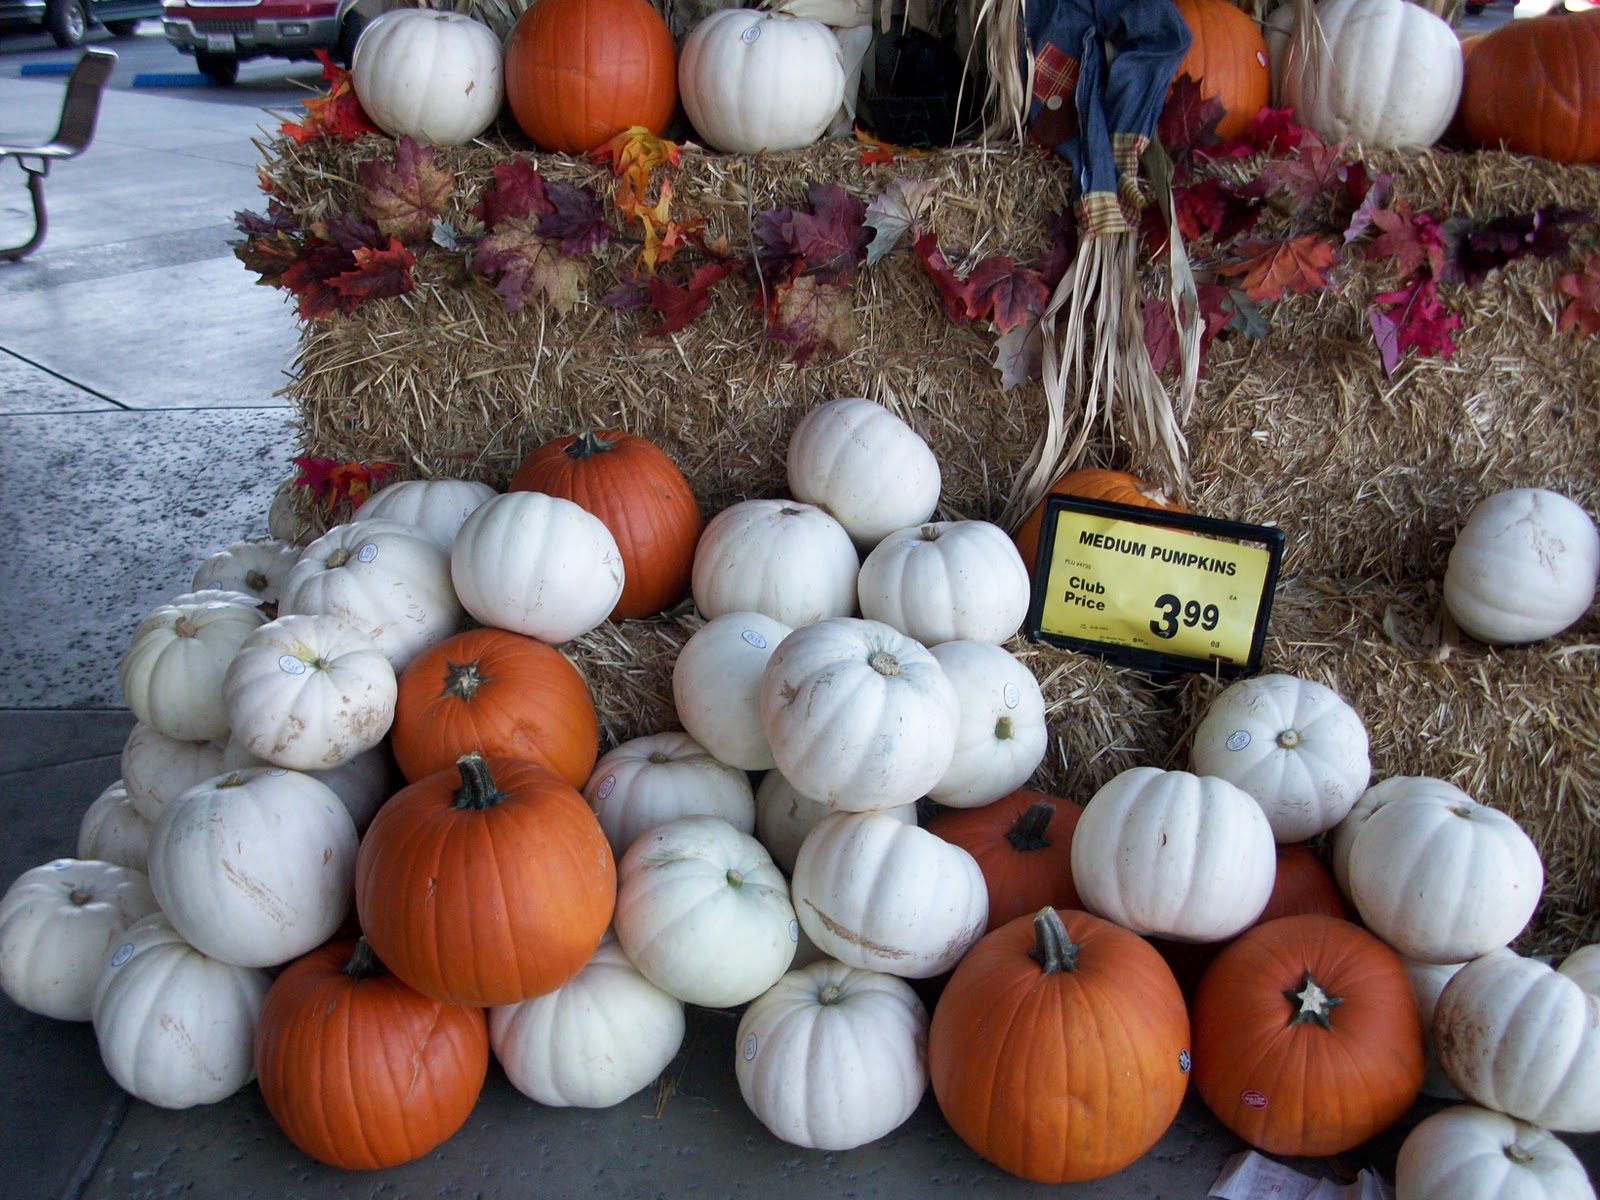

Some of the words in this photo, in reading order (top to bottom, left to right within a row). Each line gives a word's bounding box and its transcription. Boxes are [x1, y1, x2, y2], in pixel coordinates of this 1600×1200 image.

[1079, 531, 1147, 557] MEDIUM
[1150, 546, 1237, 576] PUMPKINS
[1069, 576, 1105, 595] Club
[1064, 591, 1105, 611] Price
[1210, 640, 1221, 649] ea
